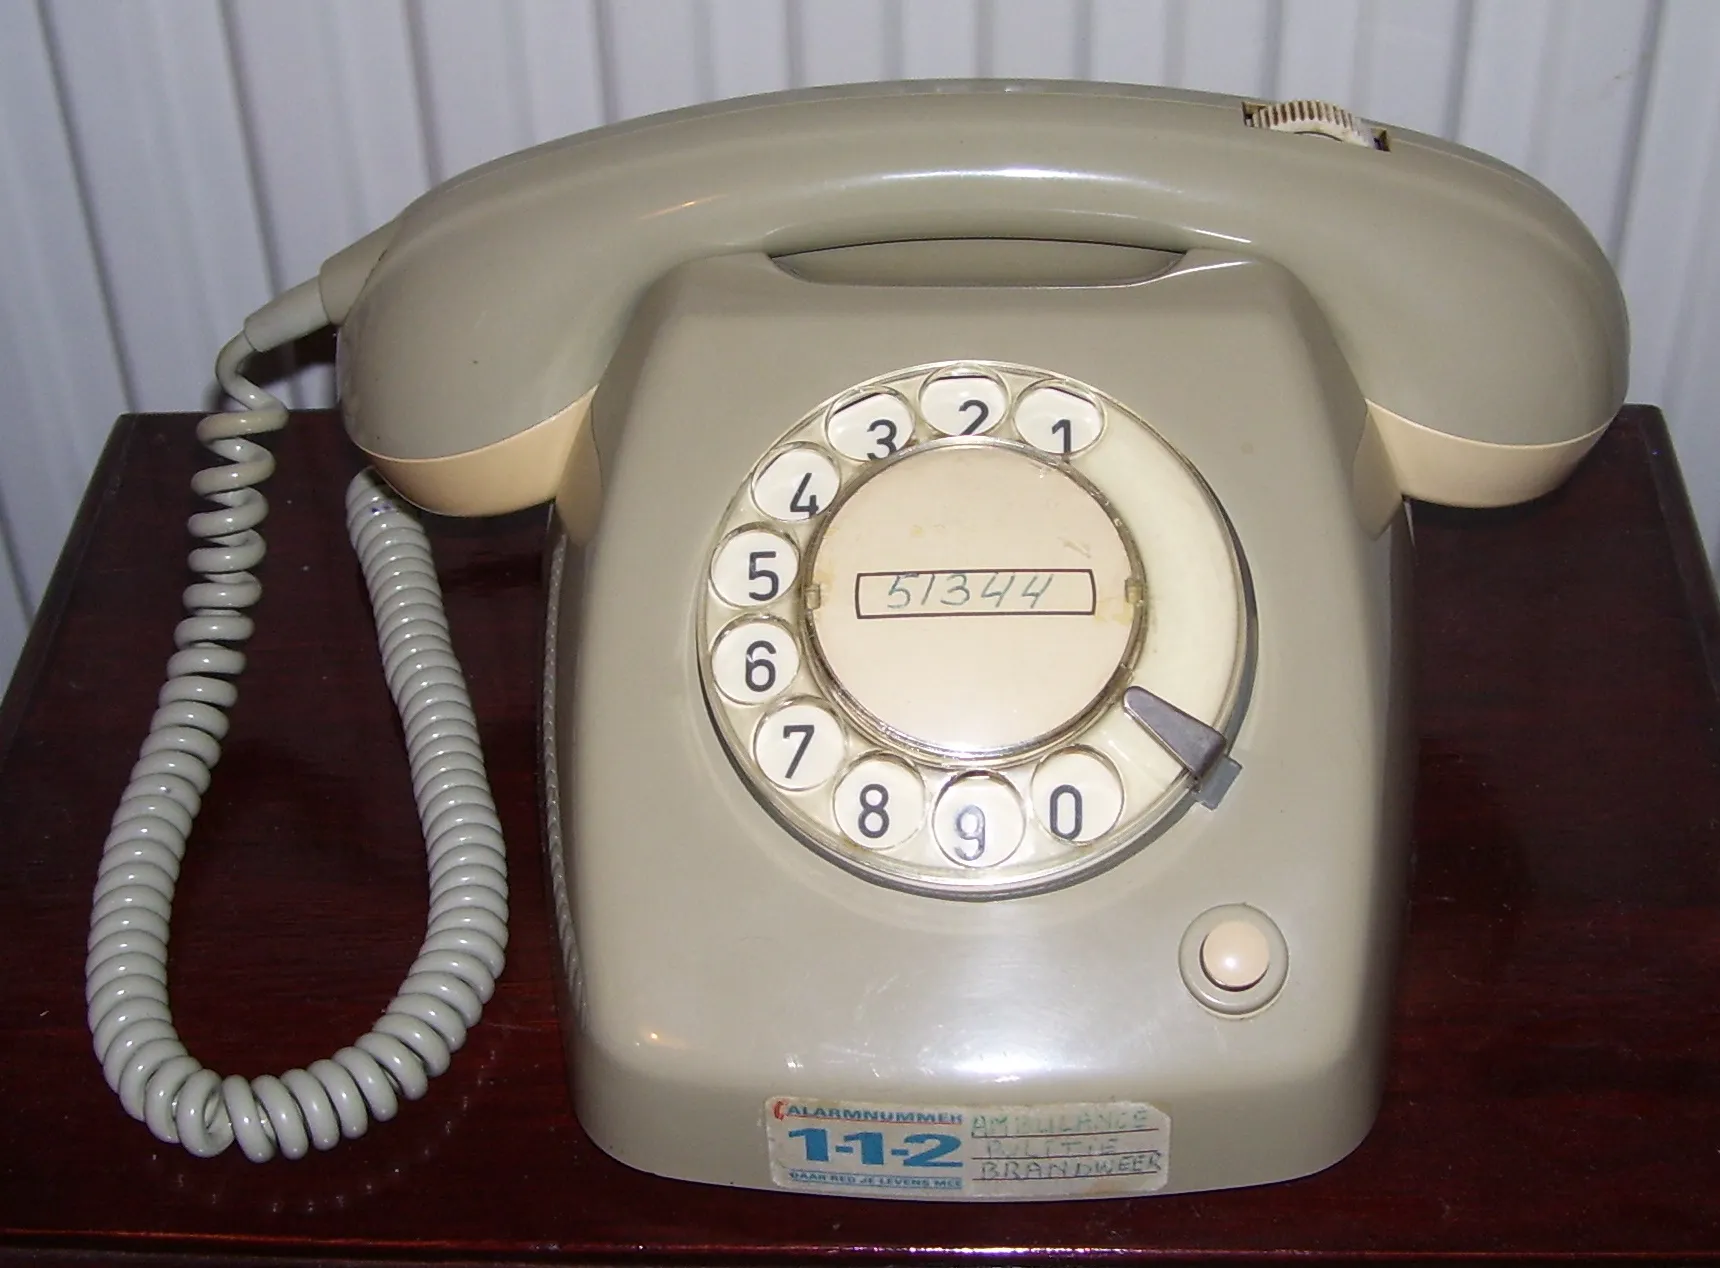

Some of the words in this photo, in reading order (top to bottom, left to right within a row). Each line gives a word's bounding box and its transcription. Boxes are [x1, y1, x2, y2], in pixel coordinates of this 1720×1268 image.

[866, 419, 898, 461] 3
[958, 399, 989, 436] 2
[1051, 419, 1072, 456] 1
[789, 472, 818, 518] 4
[748, 550, 780, 601] 5
[887, 571, 1055, 609] 51344
[745, 640, 777, 692] 6
[782, 724, 815, 779] 7
[858, 783, 890, 838] 8
[953, 804, 986, 861] 9
[1049, 784, 1083, 840] 0
[788, 1127, 964, 1167] 1-1-2
[980, 1152, 1162, 1180] BRANDWEER
